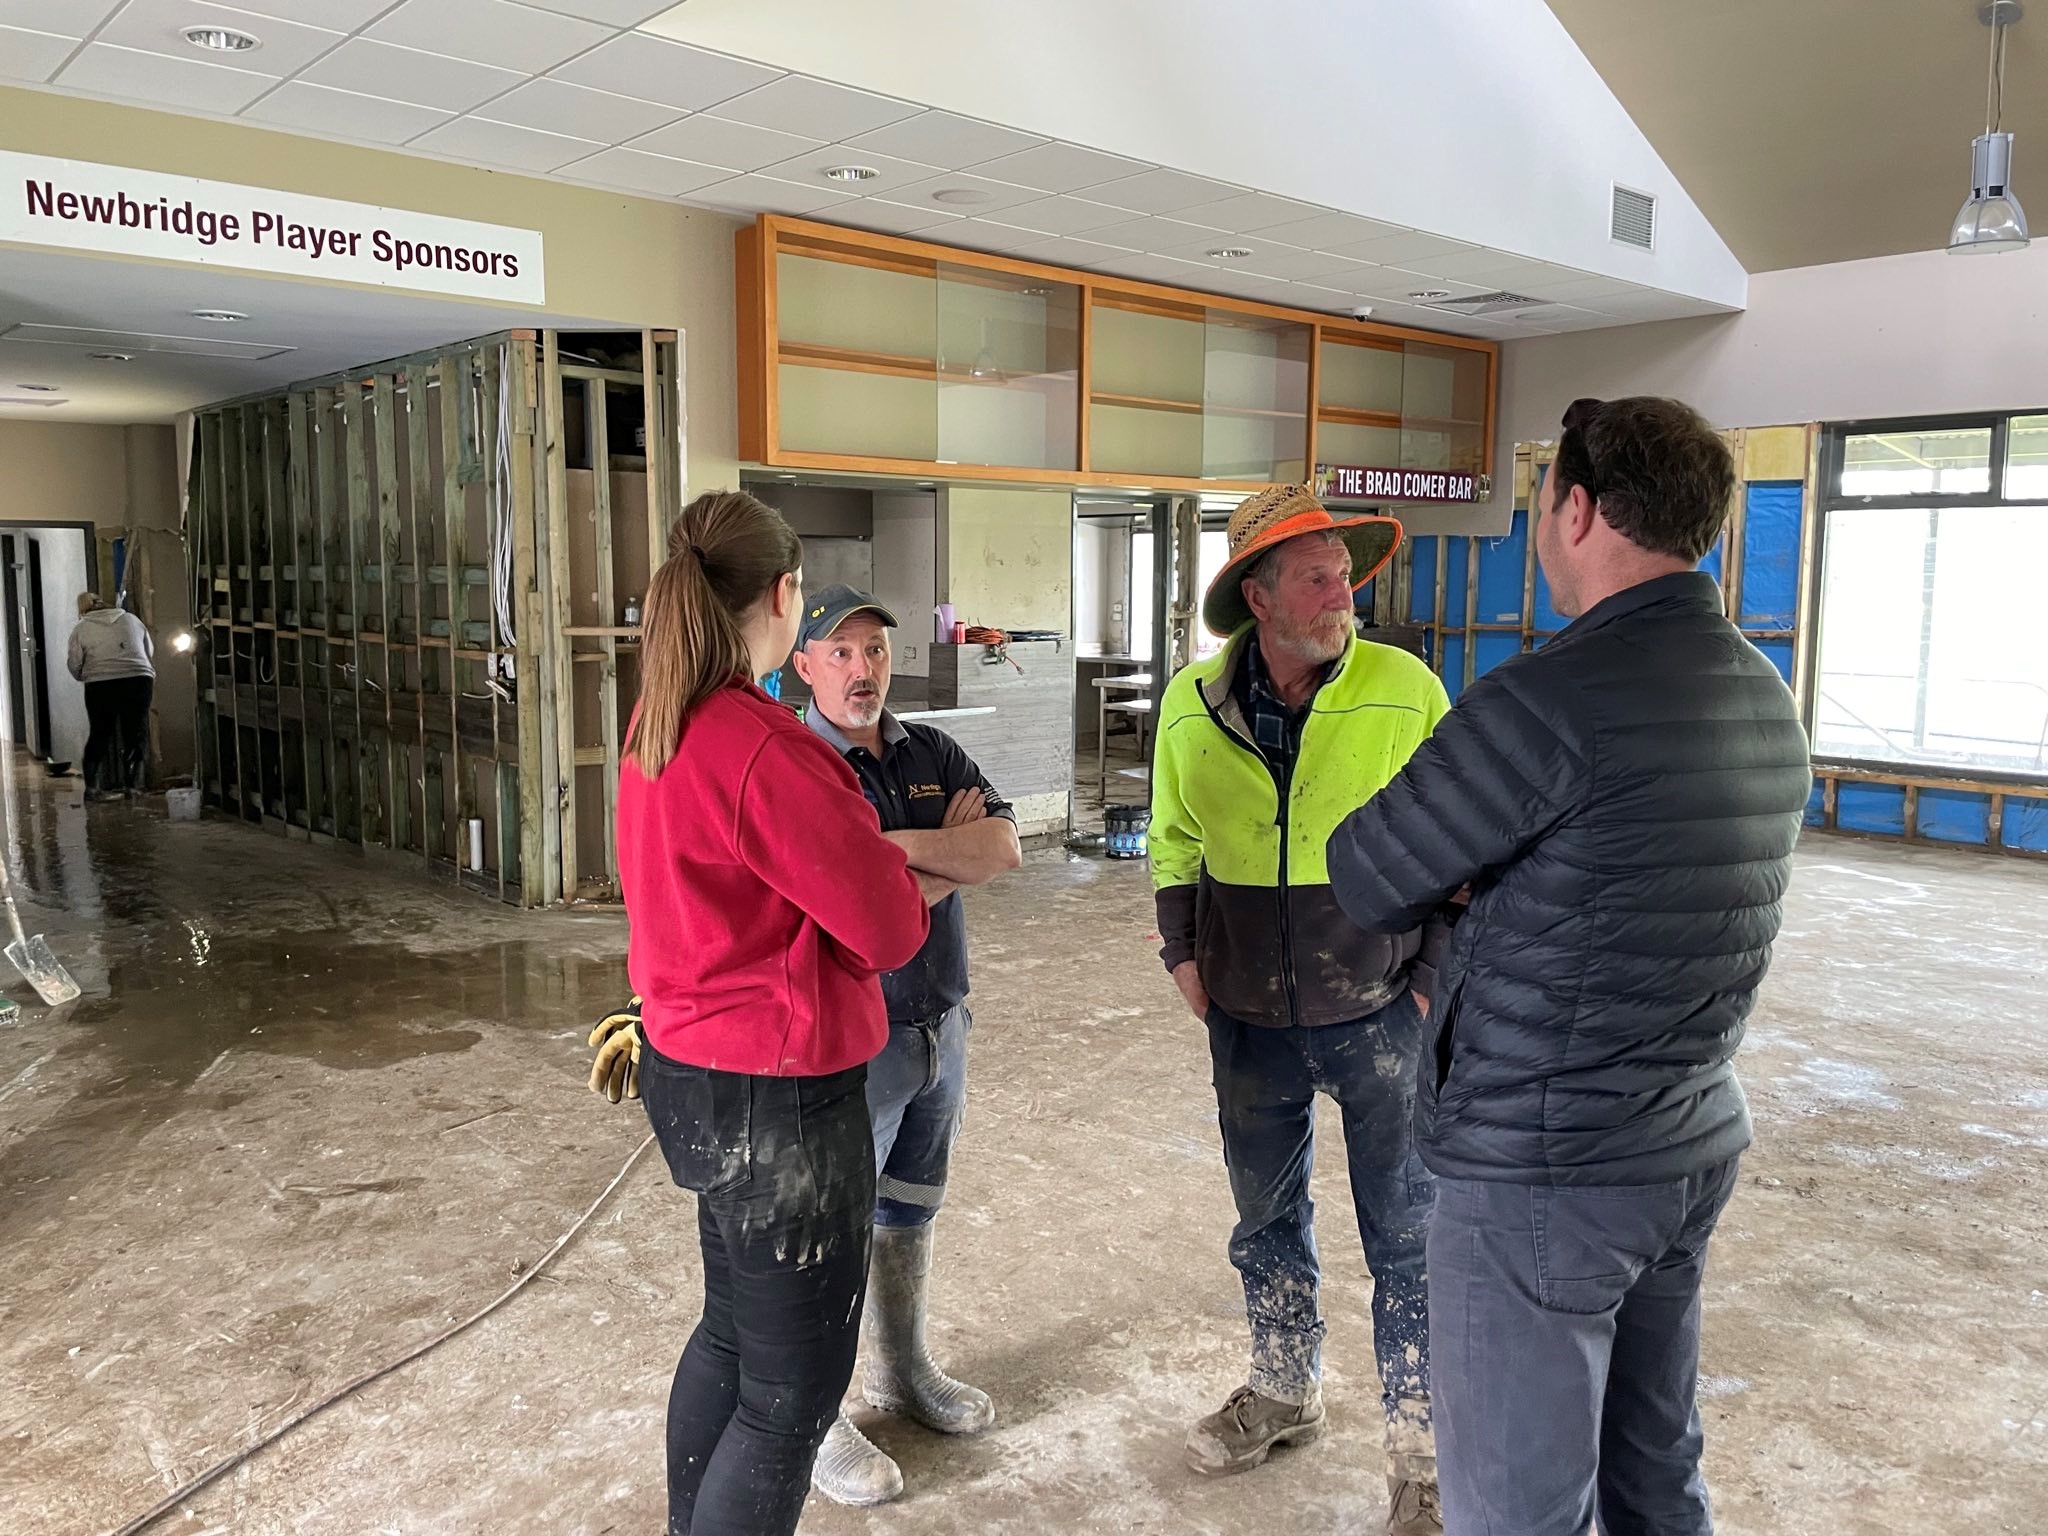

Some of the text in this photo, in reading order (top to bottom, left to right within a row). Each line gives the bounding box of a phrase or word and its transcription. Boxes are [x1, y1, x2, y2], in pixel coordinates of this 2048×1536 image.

[26, 179, 519, 278] Newbridge Player Sponsors
[1337, 468, 1472, 500] THE BRAD COMER BAR
